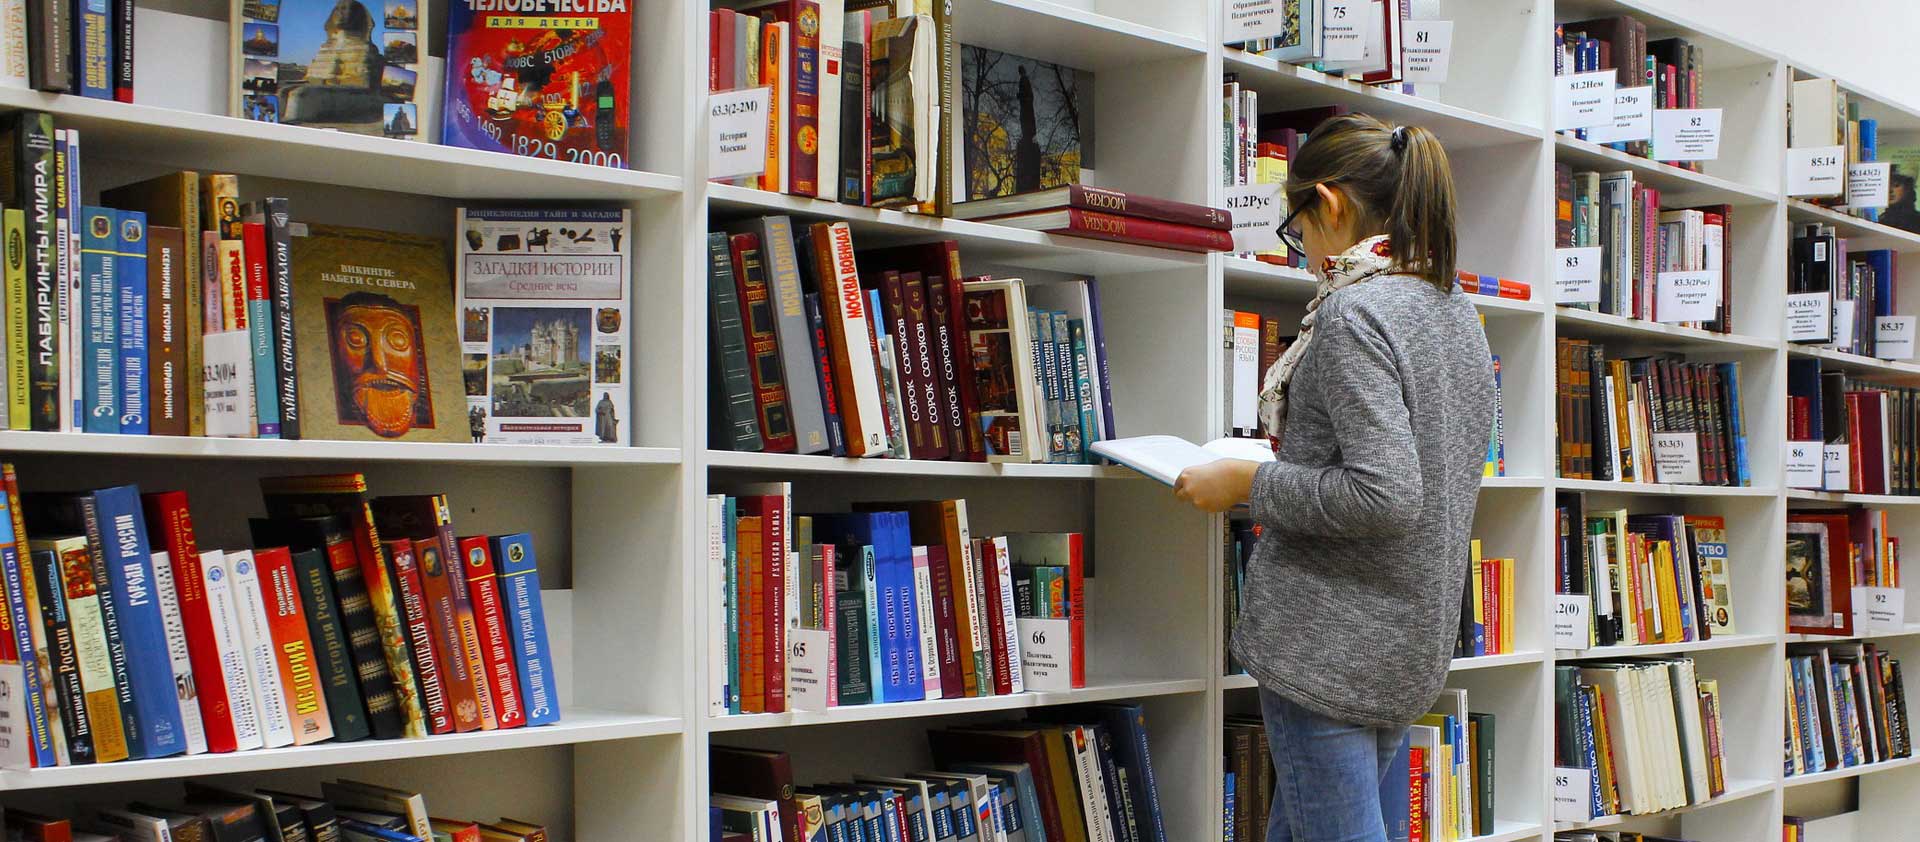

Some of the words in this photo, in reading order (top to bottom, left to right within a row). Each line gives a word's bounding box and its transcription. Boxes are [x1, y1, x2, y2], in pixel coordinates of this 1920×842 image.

[491, 19, 524, 27] ДЛЯ
[539, 17, 594, 27] ДЕТЕЙ
[1333, 6, 1346, 19] 75
[1416, 31, 1429, 43] 81
[122, 62, 132, 81] 1000
[1570, 80, 1604, 90] 81.2Нем
[712, 100, 758, 117] 63.3(2-2М)
[1614, 95, 1639, 105] 1.2Фр
[477, 115, 502, 143] 1492
[720, 131, 747, 142] История
[1690, 117, 1702, 126] 82
[510, 133, 556, 160] 1829
[720, 144, 747, 153] Москвы
[1811, 156, 1836, 167] 85.14
[33, 159, 48, 224] МИРА
[1084, 191, 1127, 211] МОСКВА
[1226, 195, 1270, 209] 81.2Рус
[468, 209, 539, 218] ЭНЦИКЛОПЕДИЯ
[544, 210, 569, 218] ТАЙН
[581, 210, 621, 218] ЗАГАДОК
[1082, 214, 1127, 235] МОСКВА
[771, 223, 794, 271] ВОЕННАЯ
[833, 227, 856, 273] ВОЕННАЯ
[1566, 256, 1579, 268] 83
[162, 248, 171, 299] ВСЕМИРНАЯ
[253, 263, 264, 281] мир
[276, 242, 291, 309] ЗАБРАЛОМ
[321, 272, 364, 286] НАБЕГИ
[366, 276, 374, 286] С
[375, 277, 416, 291] СЕВЕРА
[340, 263, 395, 277] ВИКИНГИ:
[473, 261, 541, 276] ЗАГАДКИ
[547, 261, 614, 276] ИСТОРИИ
[1674, 278, 1711, 288] 83.3(2Рос)
[13, 277, 22, 303] МИРА
[36, 229, 53, 366] ЛАБИРИНТЫ
[509, 281, 552, 292] Средние
[555, 282, 578, 291] века
[783, 273, 801, 317] МОСКВА
[843, 275, 863, 319] МОСКВА
[254, 284, 267, 356] Средневековый
[1787, 300, 1821, 309] 85.143(3)
[14, 307, 25, 356] ДРЕВНЕГО
[163, 302, 172, 343] ИСТОРИЯ
[1880, 322, 1904, 331] 85.37
[279, 312, 293, 371] СКРЫТЫЕ
[897, 318, 912, 374] СОРОКОВ
[916, 322, 931, 378] СОРОКОВ
[939, 325, 953, 381] СОРОКОВ
[1043, 342, 1052, 378] ИСТОРИЯ
[1059, 343, 1067, 379] ИСТОРИЯ
[1077, 353, 1088, 380] МИР
[15, 360, 25, 405] ИСТОРИЯ
[93, 348, 114, 417] ЭНЦИКЛОПЕДИЯ
[121, 357, 142, 425] ЭНЦИКЛОПЕДИЯ
[164, 361, 173, 419] СПРАВОЧНИК
[281, 375, 297, 421] ТАЙНЫ.
[1079, 382, 1093, 412] ВЕСЬ
[906, 379, 920, 422] СОРОК
[924, 382, 938, 424] СОРОК
[947, 385, 961, 427] СОРОК
[1658, 439, 1684, 449] 83.3(3)
[1792, 449, 1804, 458] 86
[115, 514, 139, 558] РОССИИ
[179, 507, 200, 559] СССР
[996, 546, 1009, 577] А-Я
[123, 562, 149, 606] ГОРОДА
[189, 561, 200, 599] история
[271, 569, 287, 617] Справочник
[280, 565, 296, 615] абитуриента
[308, 567, 331, 620] России
[4, 552, 23, 607] ИСТОРИЯ
[17, 608, 31, 653] РОССИИ
[102, 590, 120, 641] ЦАРСКИЕ
[885, 587, 896, 639] МОСКВИЧИ
[902, 587, 912, 638] МОСКВИЧИ
[1001, 582, 1013, 618] БИЗНЕС
[1072, 587, 1084, 621] ВЛАСТЬ
[1875, 594, 1887, 603] 92
[462, 619, 479, 661] ИМПЕРИЯ
[486, 615, 503, 645] РУССКОЙ
[518, 608, 535, 639] РУССКОЙ
[1032, 630, 1046, 645] 66
[319, 622, 348, 687] История
[493, 645, 505, 661] МИР
[525, 640, 537, 656] МИР
[793, 642, 806, 657] 65
[890, 648, 898, 666] ВСЕ
[906, 648, 915, 666] ВСЕ
[1005, 629, 1020, 686] ЭКОНОМИКА
[26, 660, 38, 687] АТЛАС
[69, 673, 82, 693] даты
[110, 643, 131, 704] ДИНАСТИИ
[411, 621, 445, 715] ЭНЦИКЛОПЕДИЯ
[891, 667, 901, 685] МЫ
[907, 666, 916, 684] МЫ
[998, 652, 1008, 686] РЫНОК:
[473, 664, 491, 720] РОССИЙСКАЯ
[495, 662, 520, 723] ЭНЦИКЛОПЕДИЯ
[527, 659, 550, 719] ЭНЦИКЛОПЕДИЯ
[31, 689, 48, 751] ШКОЛЬНИКА
[72, 694, 88, 736] Памятные
[231, 700, 245, 740] ИСТОРИЯ
[262, 693, 277, 733] ИСТОРИЯ
[1584, 700, 1593, 726] ВЕКА
[1556, 776, 1569, 787] 85
[1590, 749, 1603, 812] ИСКУССТВО
